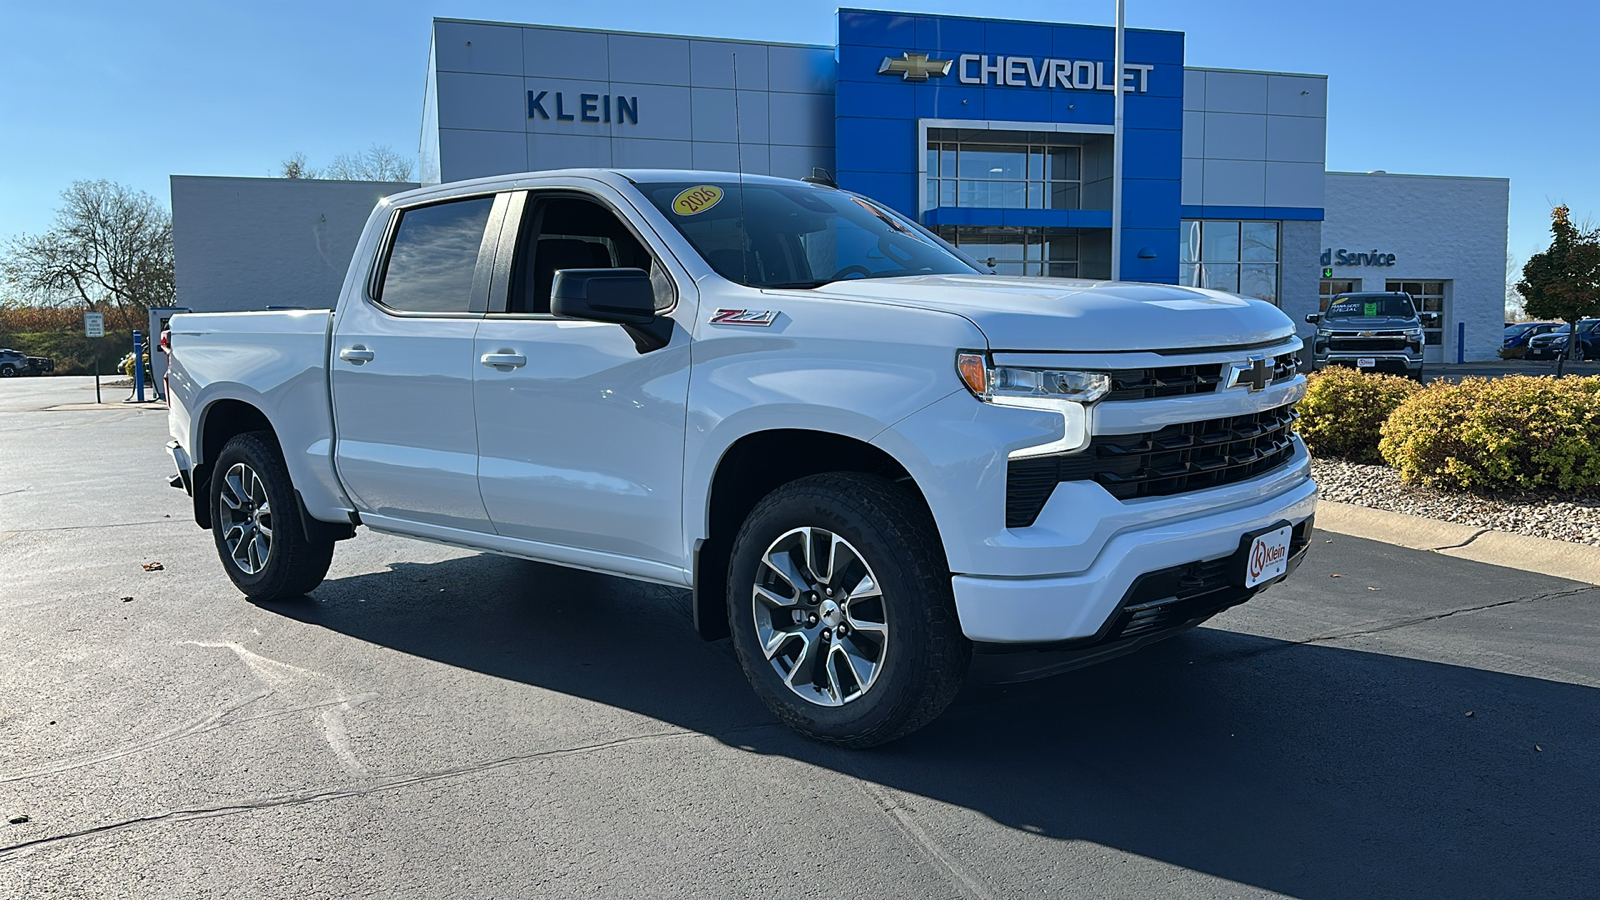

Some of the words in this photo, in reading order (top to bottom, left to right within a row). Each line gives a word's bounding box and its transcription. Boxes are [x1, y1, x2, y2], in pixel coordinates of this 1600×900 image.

[959, 53, 1154, 93] CHEVROLET
[527, 90, 638, 125] KLEIN
[680, 187, 717, 212] 2026
[1335, 248, 1396, 267] Service
[708, 308, 781, 327] Z71
[1265, 543, 1285, 564] Klein
